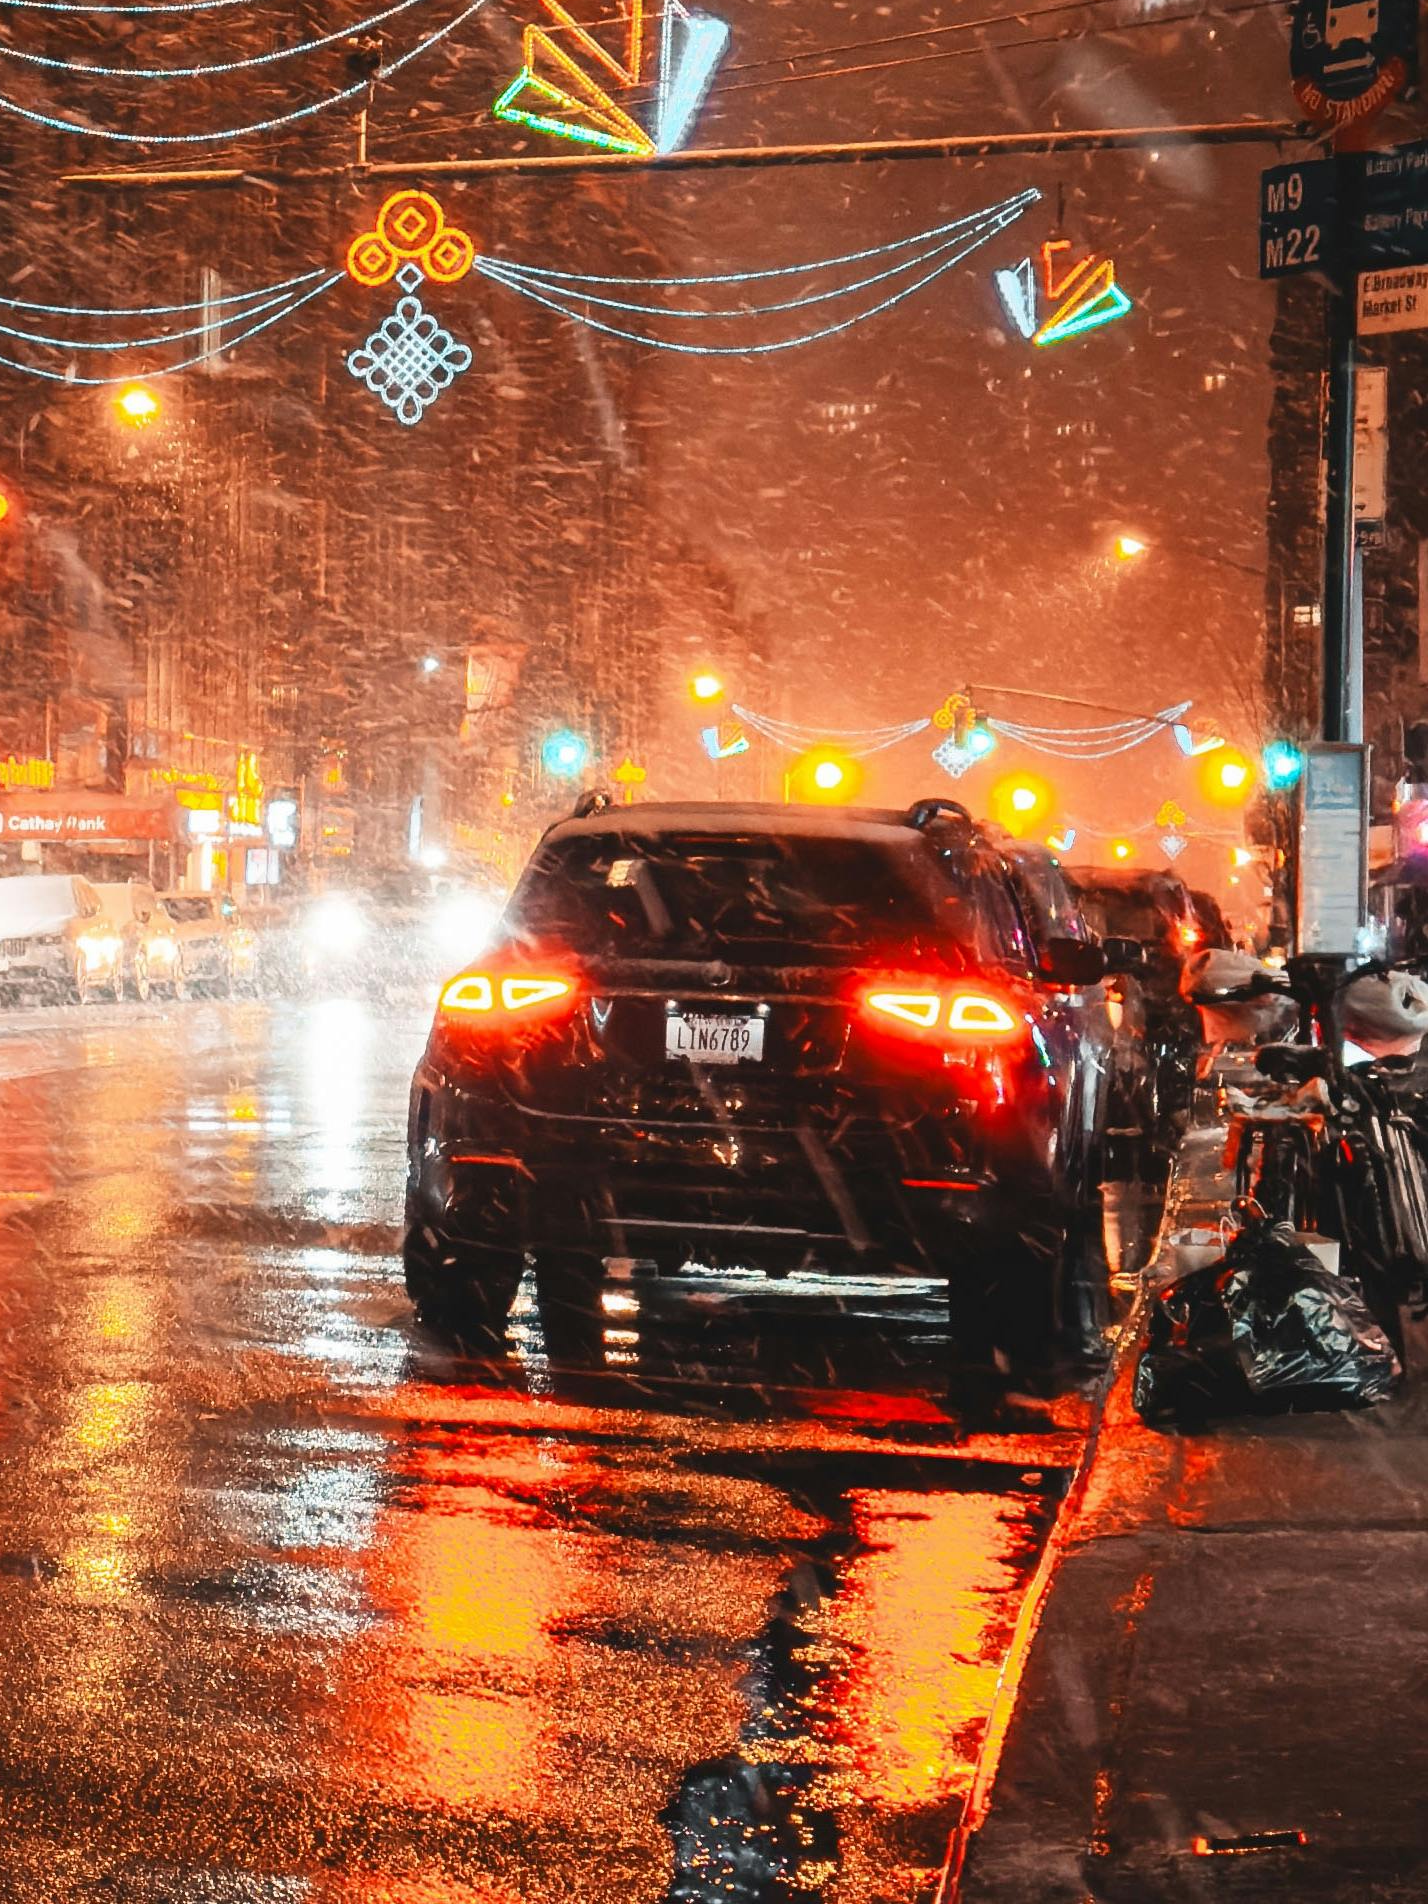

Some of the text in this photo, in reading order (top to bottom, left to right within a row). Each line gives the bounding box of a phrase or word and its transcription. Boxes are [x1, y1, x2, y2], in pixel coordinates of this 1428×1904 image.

[1326, 70, 1396, 121] STANDING
[1267, 172, 1304, 214] M9
[1265, 223, 1321, 270] M22
[1405, 295, 1417, 312] St
[7, 815, 63, 834] Cathay
[677, 1026, 750, 1052] LIN6789
